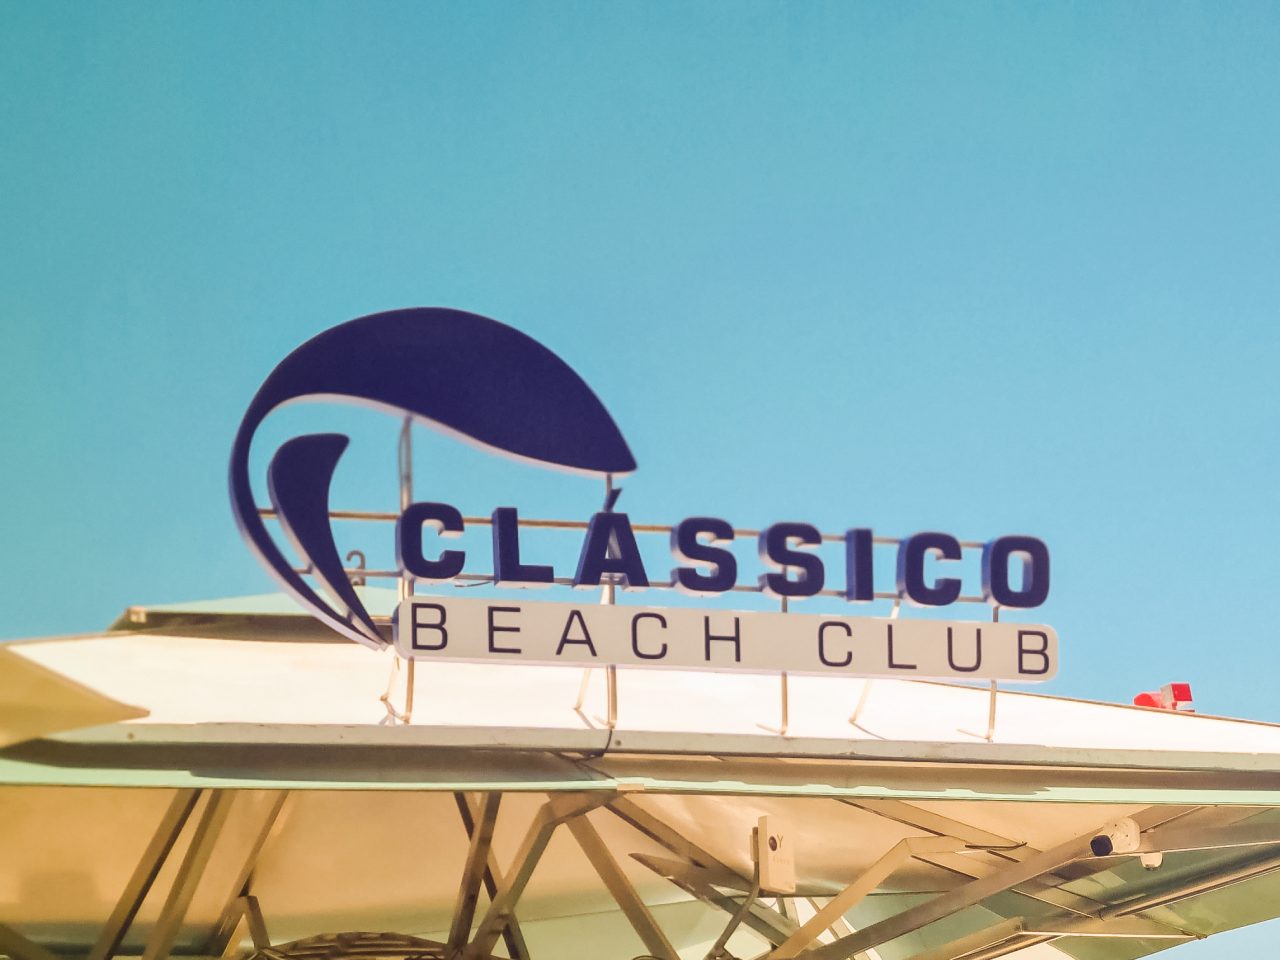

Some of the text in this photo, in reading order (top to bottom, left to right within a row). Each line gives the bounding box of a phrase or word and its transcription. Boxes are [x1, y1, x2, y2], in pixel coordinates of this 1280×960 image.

[397, 489, 1050, 608] CLÁSSICO
[411, 603, 1050, 676] BEACH CLUB
